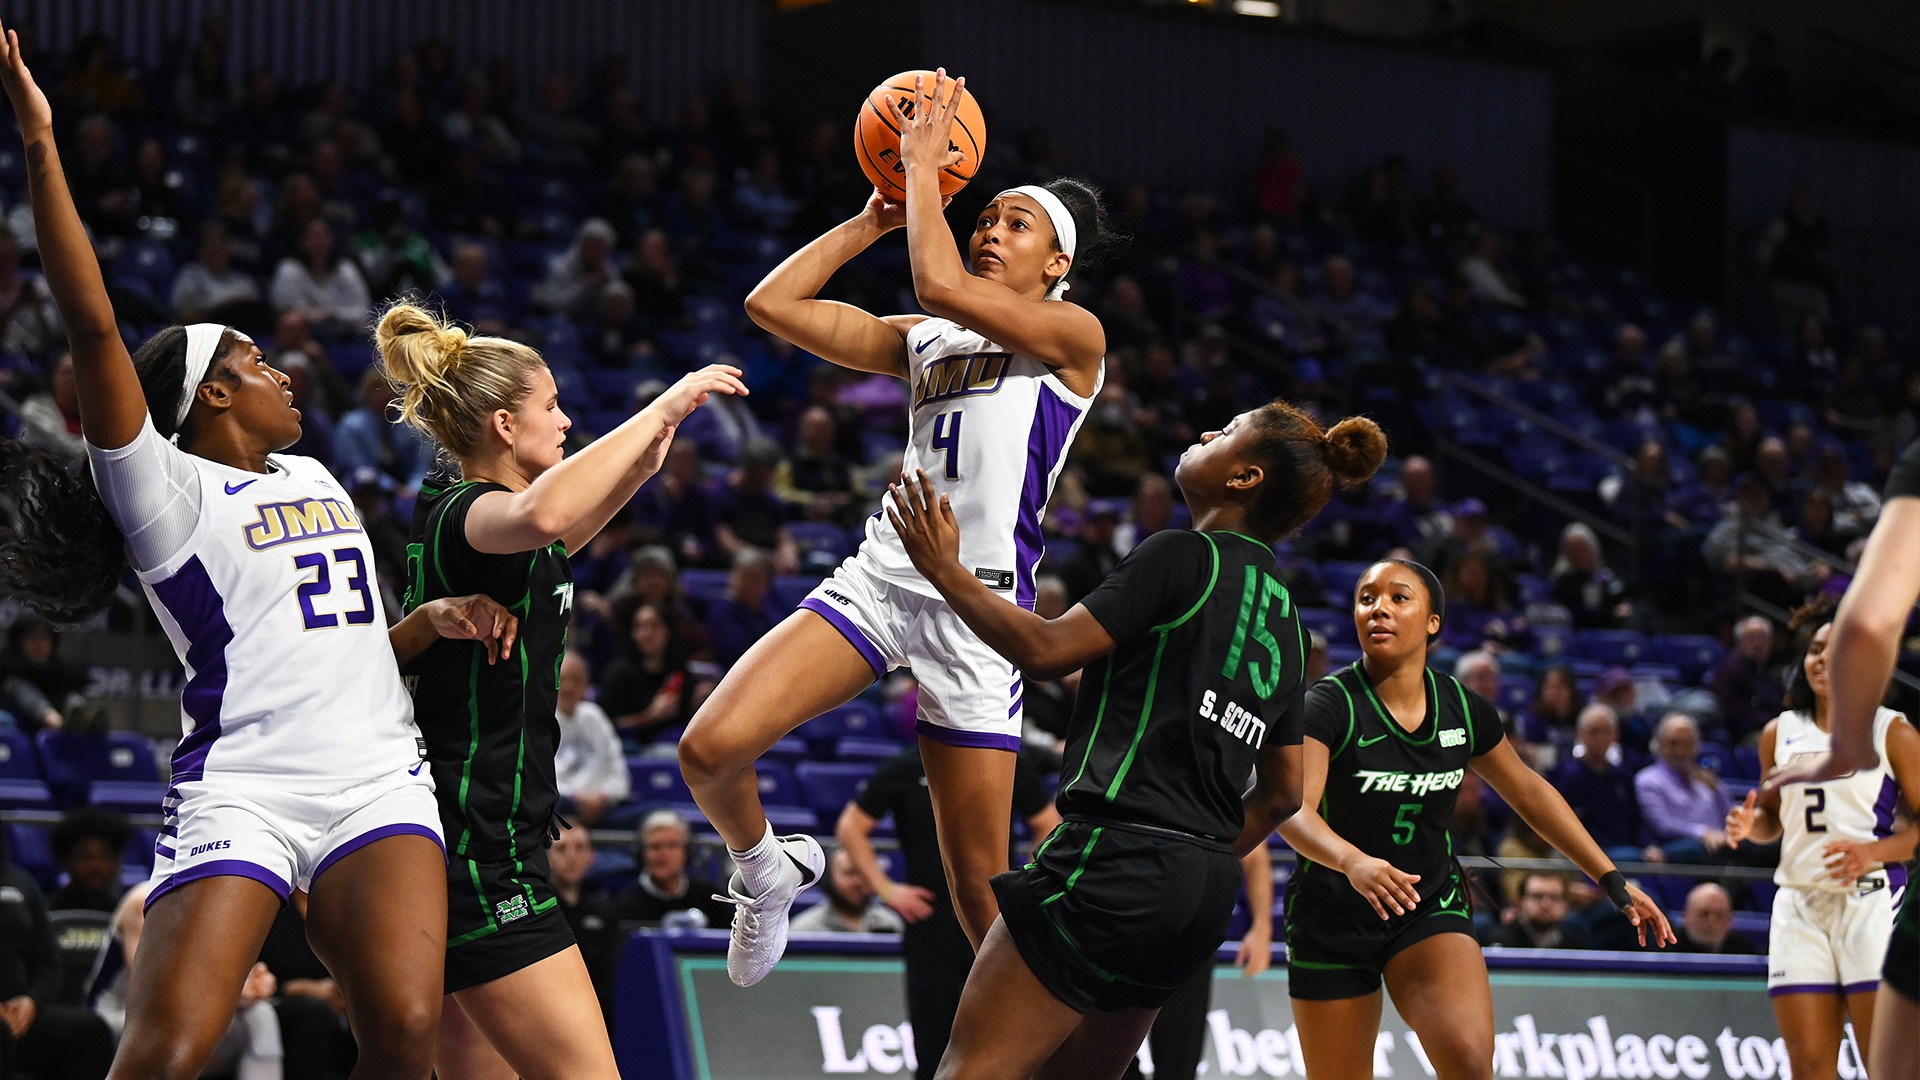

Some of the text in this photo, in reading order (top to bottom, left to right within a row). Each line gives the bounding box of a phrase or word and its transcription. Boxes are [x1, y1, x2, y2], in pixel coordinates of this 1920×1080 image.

[915, 354, 1009, 409] JMU
[931, 410, 964, 481] 4
[245, 498, 362, 549] JMU
[292, 547, 375, 632] 23
[824, 589, 851, 606] UKES
[1221, 565, 1290, 700] 15
[1199, 689, 1267, 750] S. SCOTT
[1438, 728, 1467, 748] SBC
[1354, 768, 1464, 797] THE HERD
[1391, 803, 1423, 846] 5
[1804, 787, 1827, 833] 2
[190, 839, 232, 858] DUKES
